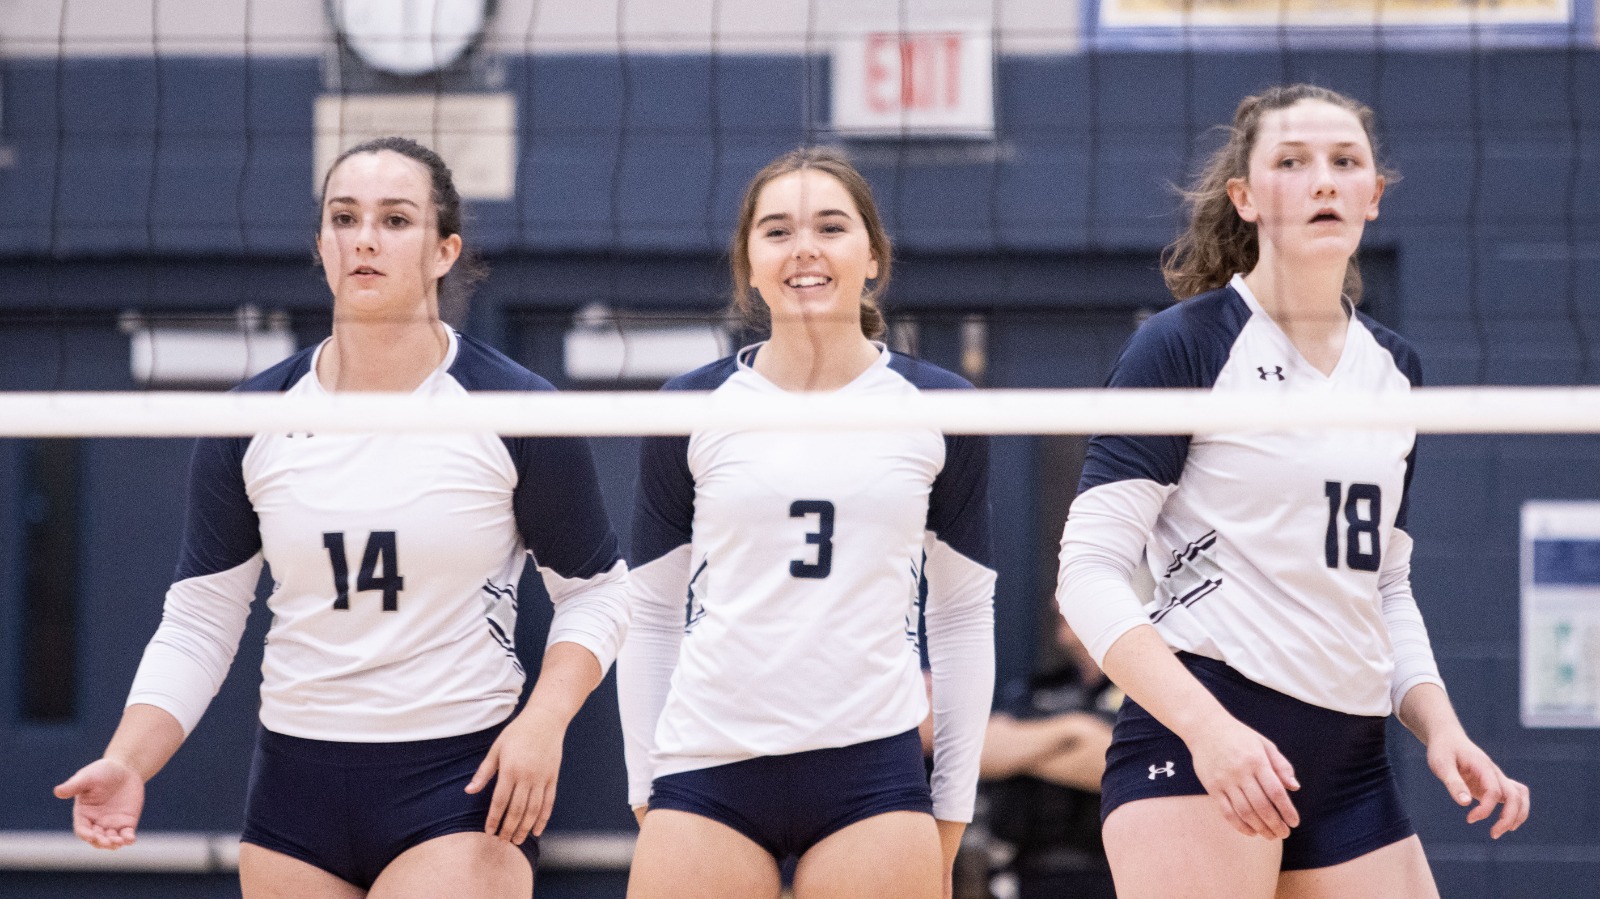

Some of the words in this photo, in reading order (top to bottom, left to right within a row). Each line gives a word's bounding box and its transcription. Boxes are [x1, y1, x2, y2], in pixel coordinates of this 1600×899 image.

[864, 32, 963, 112] EXIT
[788, 499, 835, 579] 3
[1324, 480, 1382, 573] 18
[322, 530, 404, 612] 14
